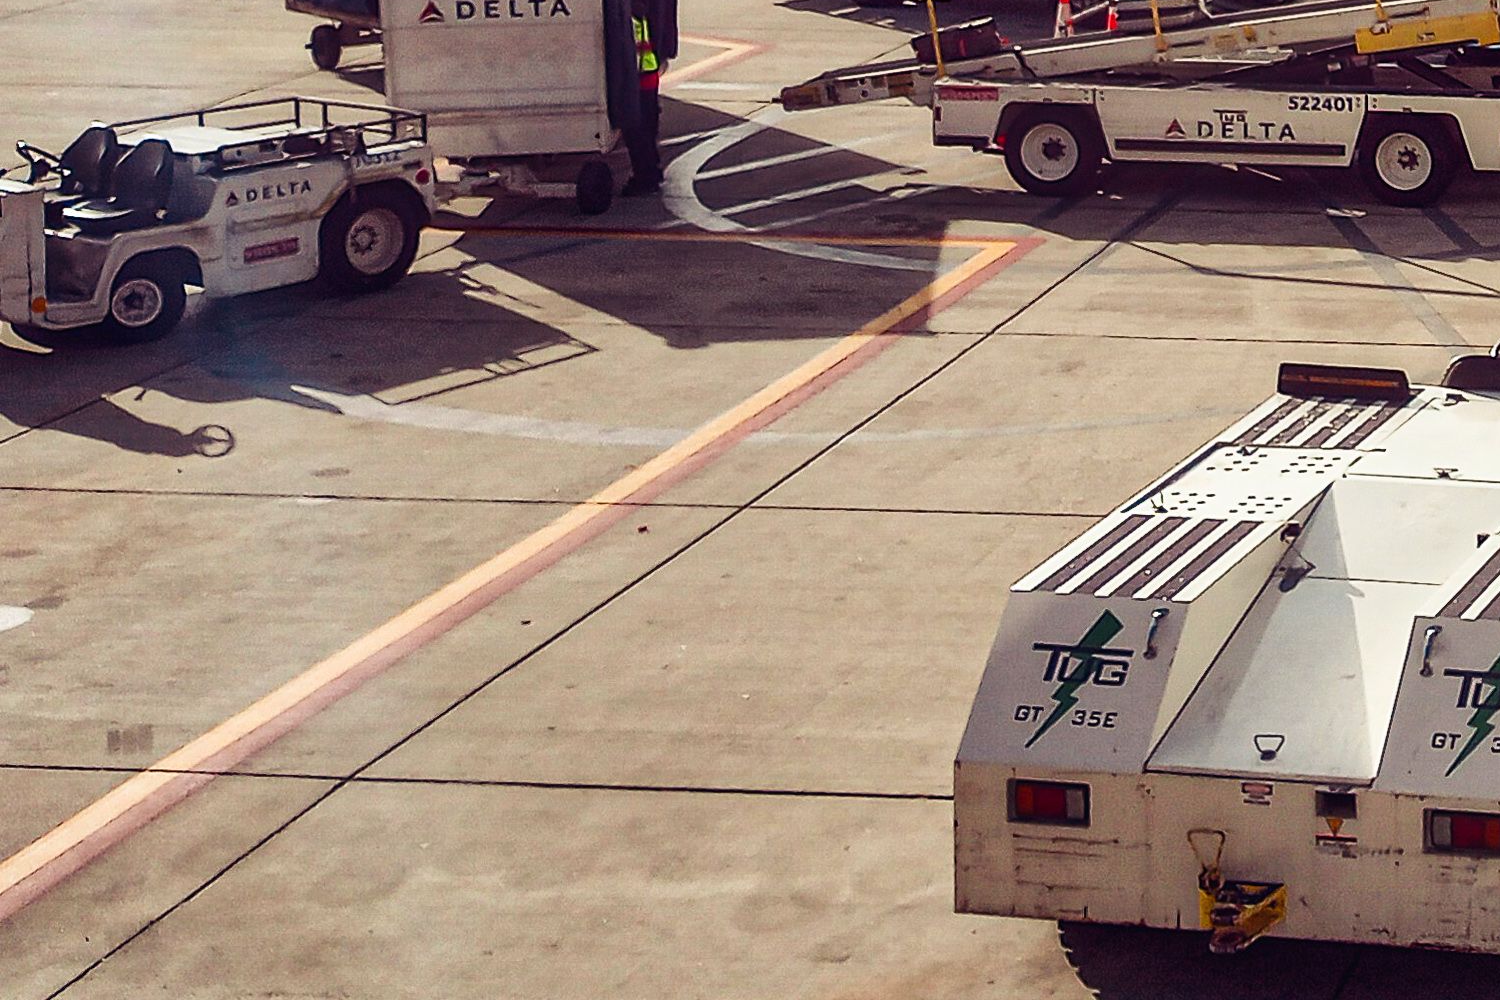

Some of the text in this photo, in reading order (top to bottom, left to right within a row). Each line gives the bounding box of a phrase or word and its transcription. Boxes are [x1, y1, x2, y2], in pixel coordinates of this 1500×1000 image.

[1288, 95, 1354, 113] 522401
[1197, 121, 1297, 142] DELTA
[245, 179, 312, 202] DELTA
[1032, 642, 1135, 687] TUG
[1014, 704, 1119, 729] GT 35E
[1431, 732, 1462, 750] GT
